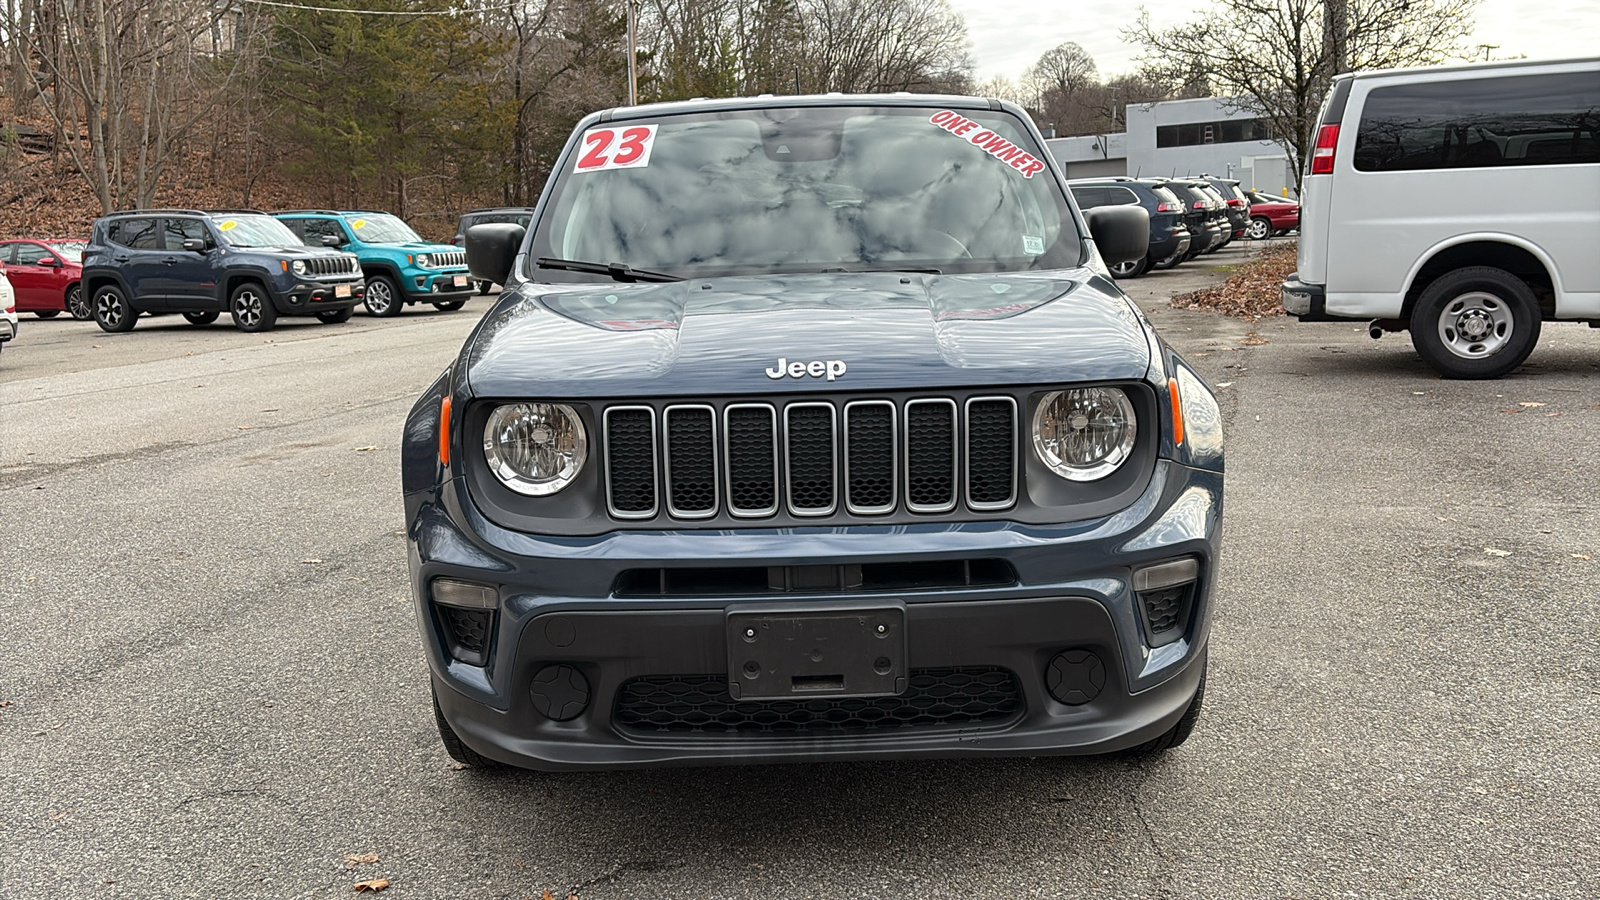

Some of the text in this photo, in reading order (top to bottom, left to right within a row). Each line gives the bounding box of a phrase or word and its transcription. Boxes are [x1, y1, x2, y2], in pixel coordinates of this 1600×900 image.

[577, 127, 652, 170] 23
[931, 111, 1044, 177] ONE OWNER
[765, 358, 847, 382] Jeep
